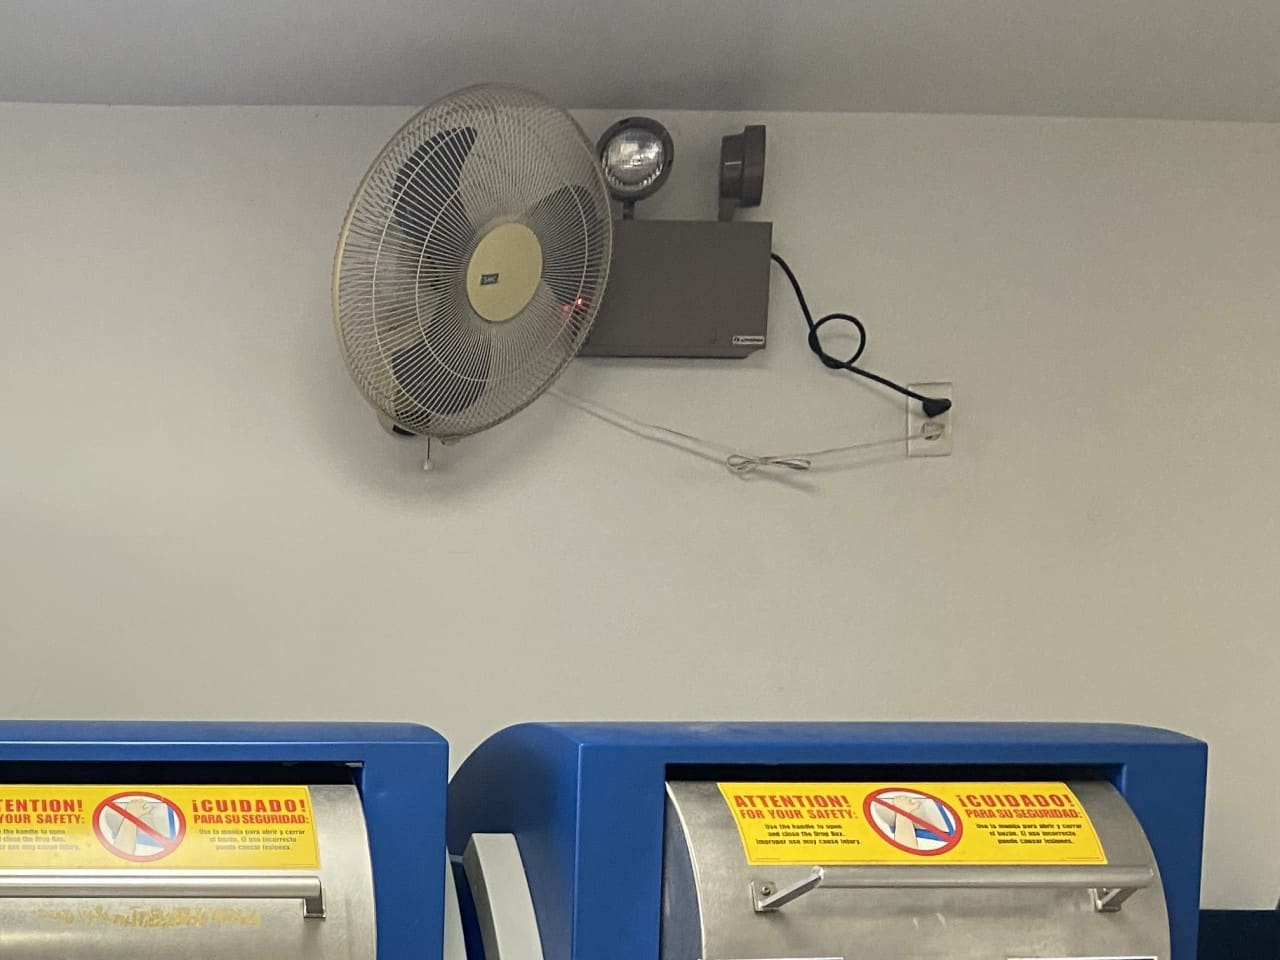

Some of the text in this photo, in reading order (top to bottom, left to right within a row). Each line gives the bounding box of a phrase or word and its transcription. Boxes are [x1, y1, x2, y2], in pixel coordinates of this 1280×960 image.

[192, 799, 307, 812] ¡CUIDADO!
[733, 795, 851, 807] ATTENTION!
[956, 794, 1075, 807] ¡CUIDADO!
[740, 810, 859, 819] FOR YOUR SAFETY:
[965, 809, 1082, 818] PARA SU SEGURIDAD:
[36, 814, 85, 824] SAFETY:
[194, 814, 310, 824] PARA SU SEGURIDAD:
